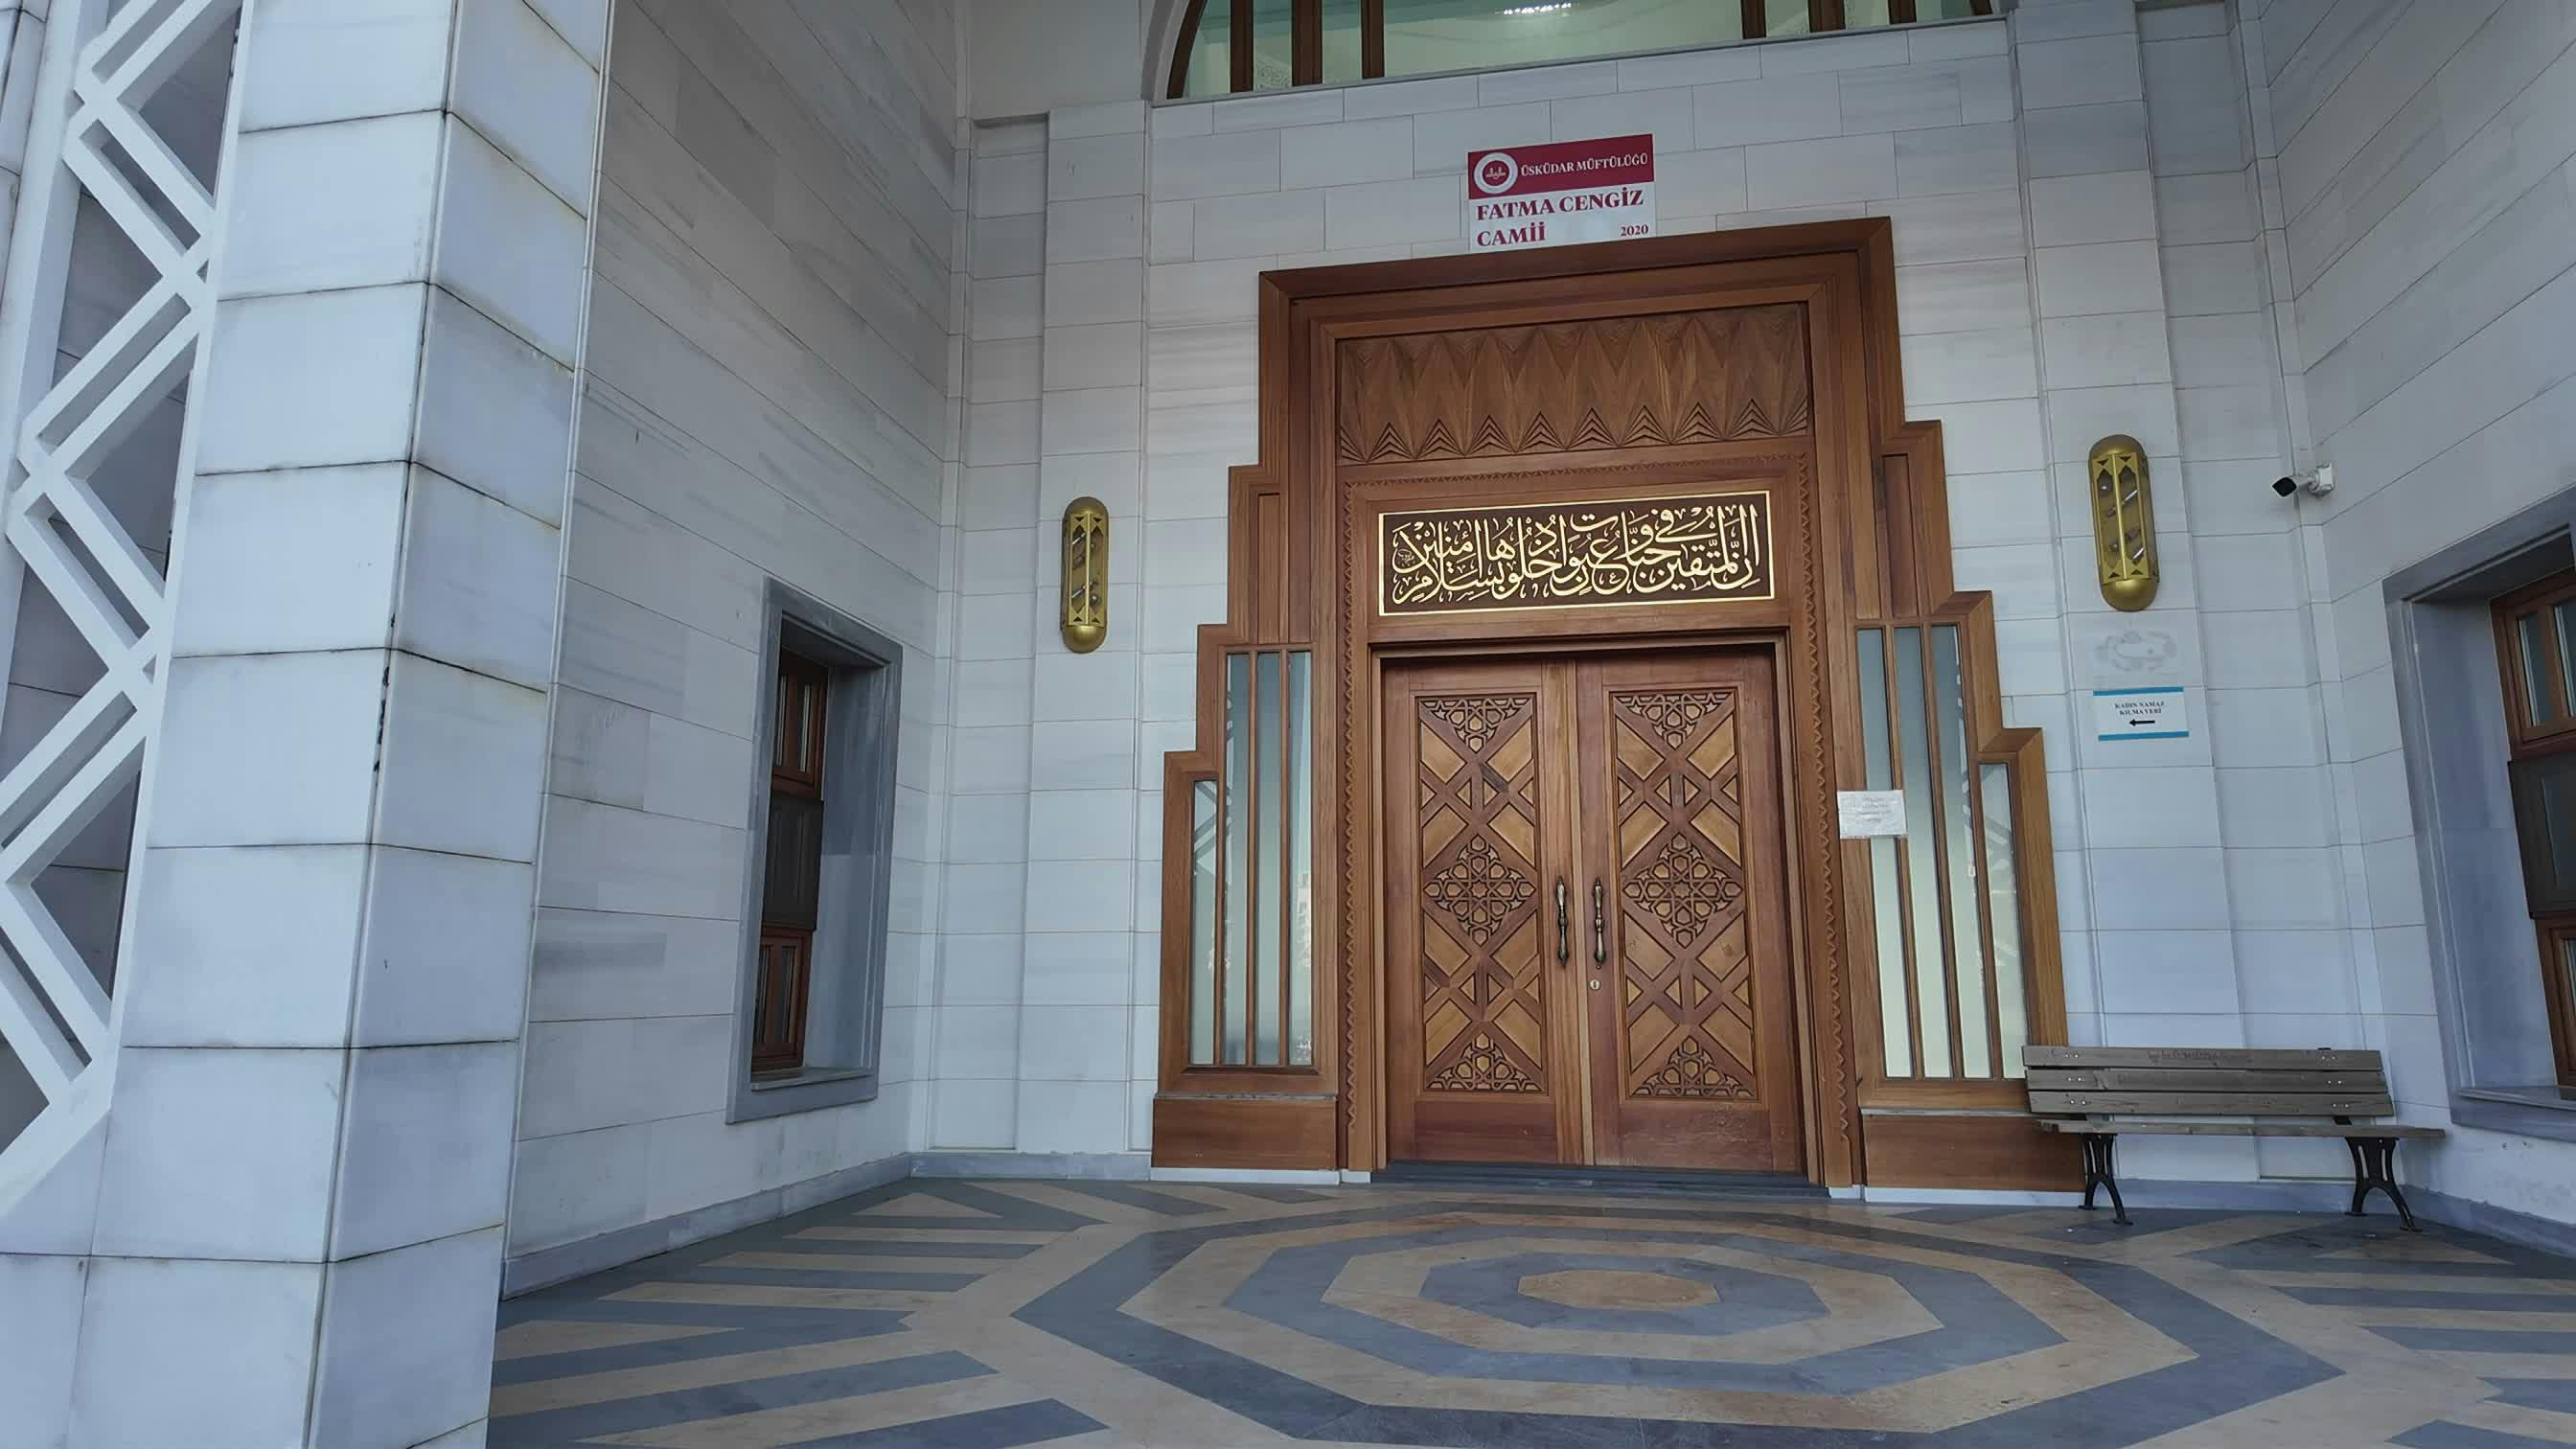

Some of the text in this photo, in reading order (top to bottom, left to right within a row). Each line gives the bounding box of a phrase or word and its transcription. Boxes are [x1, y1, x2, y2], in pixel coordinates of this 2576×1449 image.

[1521, 153, 1648, 177] ÜSKÜDAR MÜFTÜLÜĞÜ
[1477, 187, 1644, 221] FATMA CENGİZ
[1477, 221, 1546, 247] CAMİİ
[1621, 224, 1649, 238] 2020
